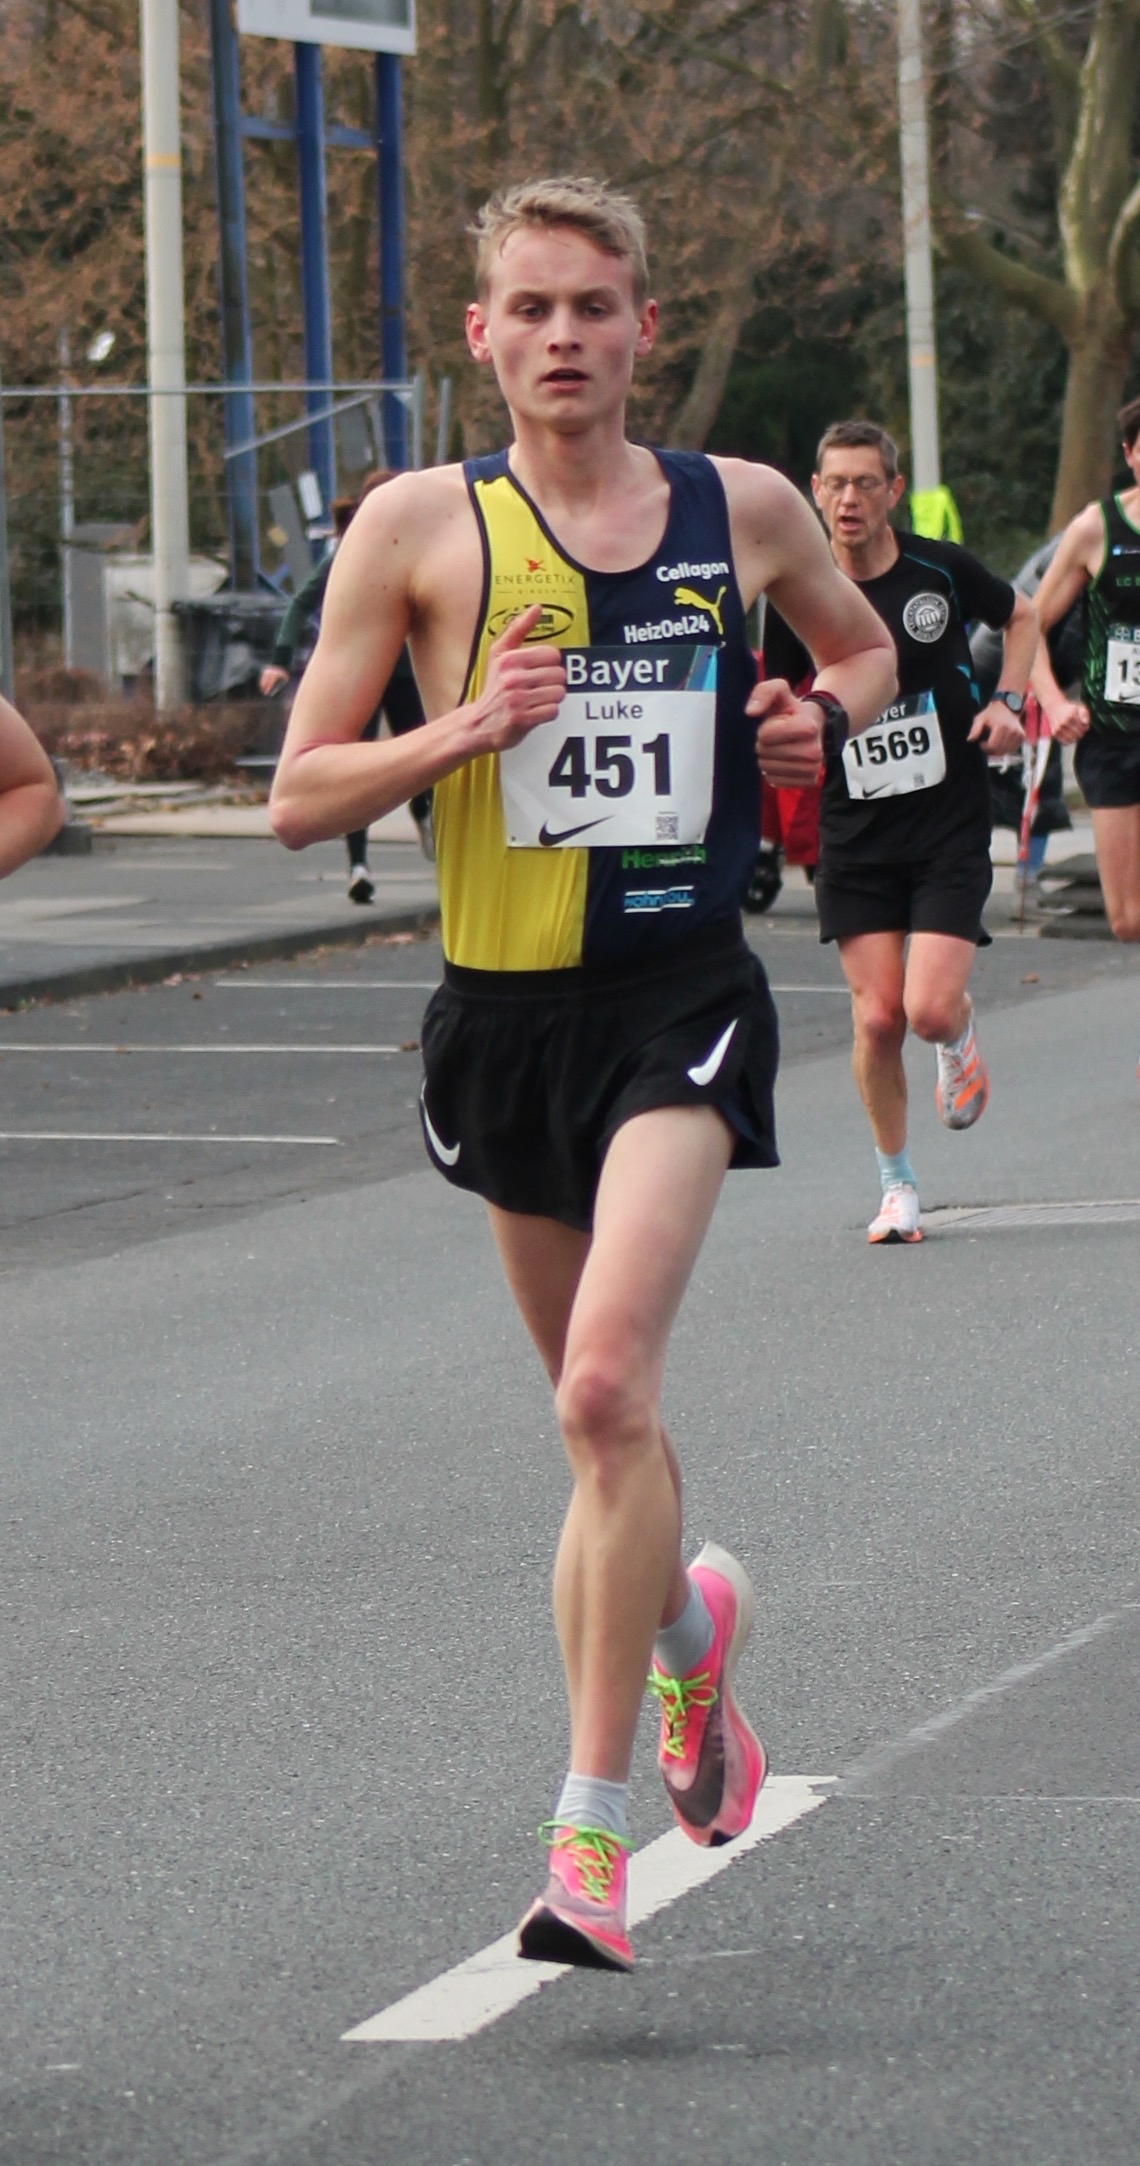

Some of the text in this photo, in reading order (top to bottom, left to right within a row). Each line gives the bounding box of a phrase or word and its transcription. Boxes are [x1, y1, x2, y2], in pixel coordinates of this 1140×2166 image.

[495, 574, 575, 585] ENERGETIX
[656, 562, 729, 582] Cellagon
[624, 615, 710, 644] HeizOel24
[566, 654, 670, 690] Bayer
[585, 700, 644, 720] Luke
[875, 702, 906, 724] yer
[849, 726, 931, 768] 1569
[548, 733, 672, 798] 451
